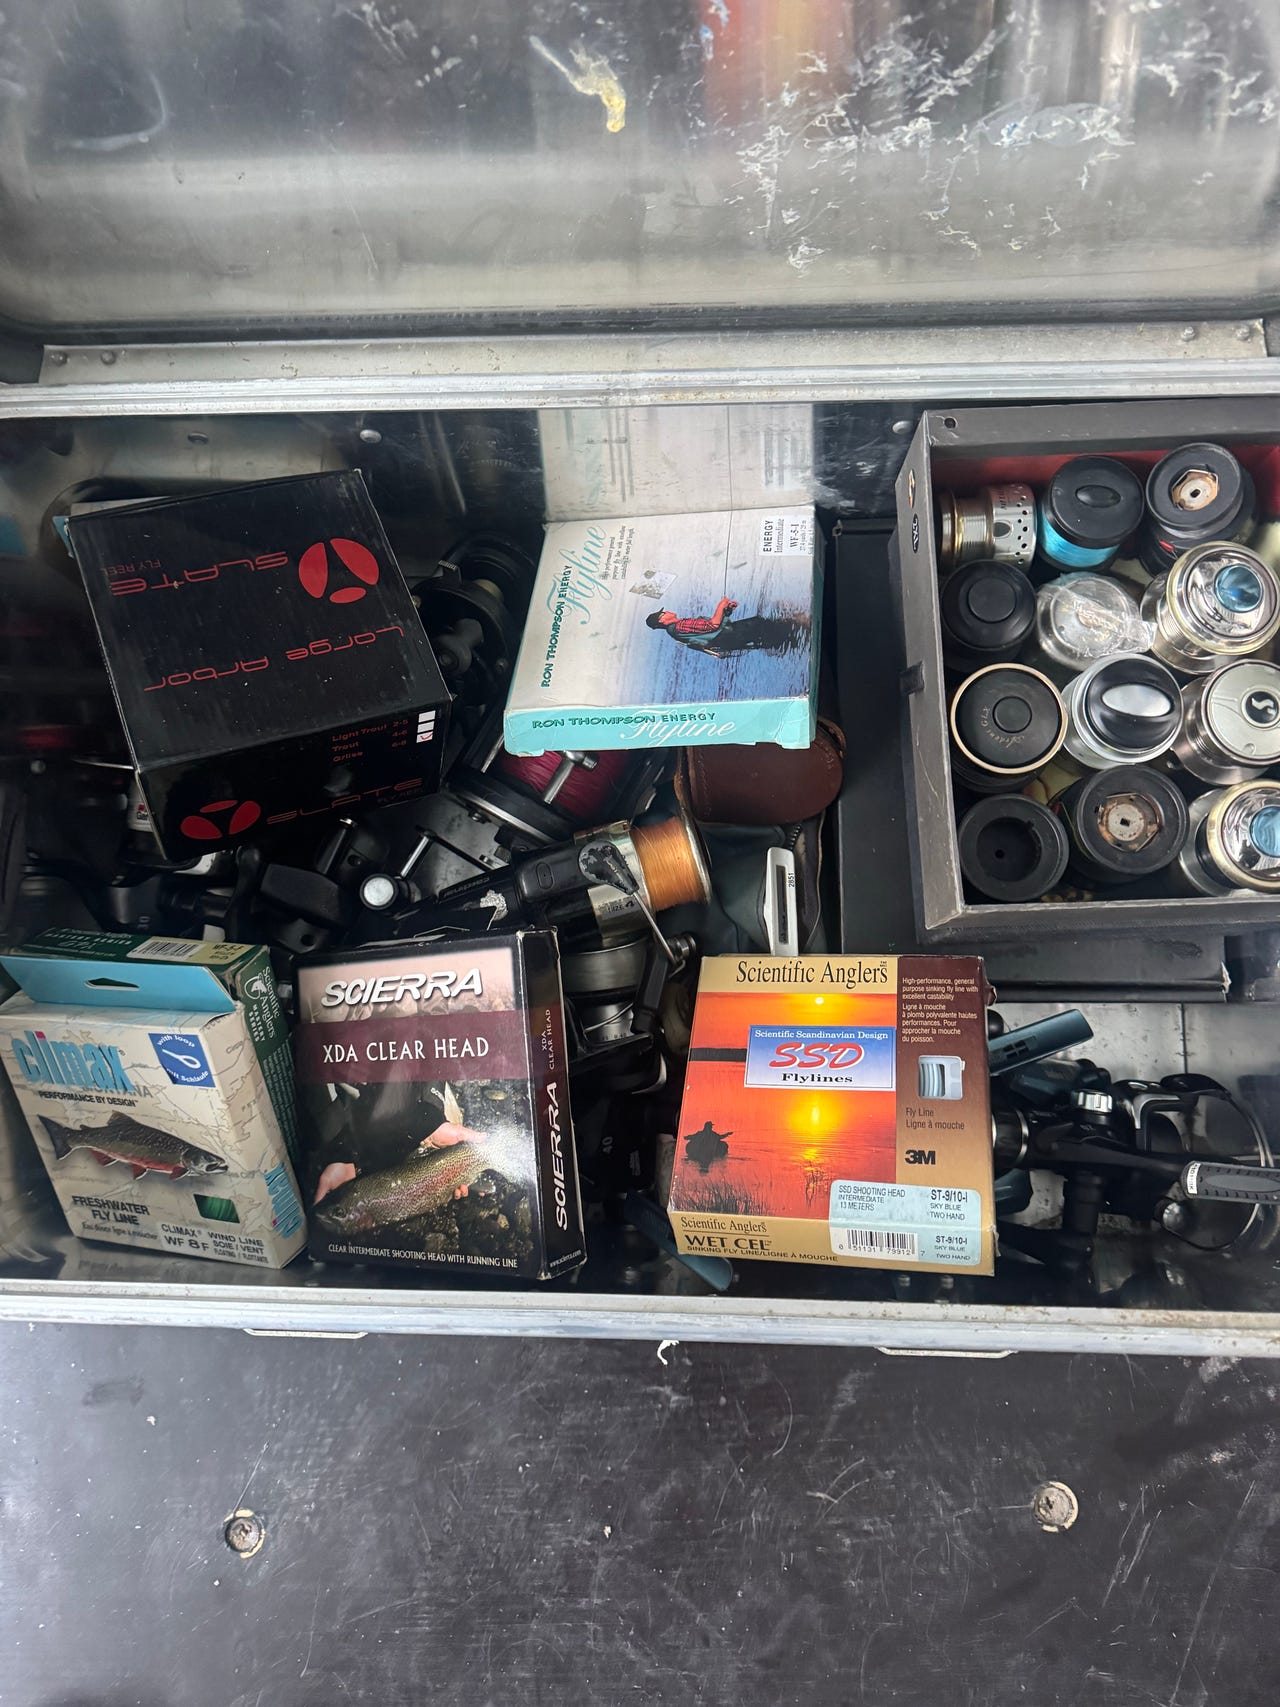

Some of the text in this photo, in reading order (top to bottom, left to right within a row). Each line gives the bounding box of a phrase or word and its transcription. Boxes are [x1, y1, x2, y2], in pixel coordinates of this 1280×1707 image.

[763, 520, 773, 552] ENERGY
[139, 559, 161, 570] FLY
[109, 551, 288, 596] SLATE
[541, 565, 573, 688] RON THOMPSON ENERGY
[286, 626, 404, 660] Large
[532, 712, 716, 729] RON THOMPSON ENERGY
[620, 708, 736, 747] Flyline
[266, 778, 423, 825] SLATE
[736, 960, 888, 990] Scientific Anglers
[953, 978, 975, 986] general
[263, 966, 280, 1019] Scientific
[321, 968, 483, 1007] SCIERRA
[926, 985, 946, 993] sinking
[902, 1003, 918, 1011] Ligne
[926, 1011, 957, 1019] polyvalente
[260, 996, 276, 1039] Anglers
[157, 1034, 196, 1048] with loop
[755, 1030, 888, 1041] Scientific Scandinavian Design
[323, 1037, 489, 1063] XDA CLEAR HEAD
[769, 1042, 865, 1070] SSD
[11, 1030, 137, 1092] climax
[782, 1073, 853, 1083] Flylines
[39, 1090, 96, 1104] PERFORMANCE
[96, 1095, 106, 1104] BY
[905, 1107, 934, 1118] Fly Line
[906, 1119, 965, 1130] Ligne à mouche
[547, 1081, 567, 1231] SCIERRA
[904, 1149, 936, 1165] 3M
[838, 1185, 905, 1198] SSD SHOOTING HEAD
[838, 1195, 884, 1203] INTERMEDIATE
[72, 1195, 150, 1215] FRESHWATER
[848, 1202, 875, 1211] METERS
[944, 1203, 961, 1211] BLUE
[91, 1209, 140, 1225] FLY LINE
[930, 1211, 965, 1220] TWO HAND
[681, 1216, 767, 1234] Scientific Anglers
[164, 1235, 209, 1251] WF 8 F
[208, 1232, 236, 1242] WIND
[239, 1237, 264, 1247] LINE
[212, 1240, 234, 1250] SOIE
[240, 1245, 265, 1255] VENT
[685, 1234, 770, 1251] WET CEL
[328, 1244, 518, 1269] CLEAR INTERMEDIATE SHOOTING HEAD WITH RUNNING LINE
[687, 1245, 721, 1253] SINKING
[723, 1247, 738, 1255] FLY
[799, 1254, 838, 1262] MOUCHE
